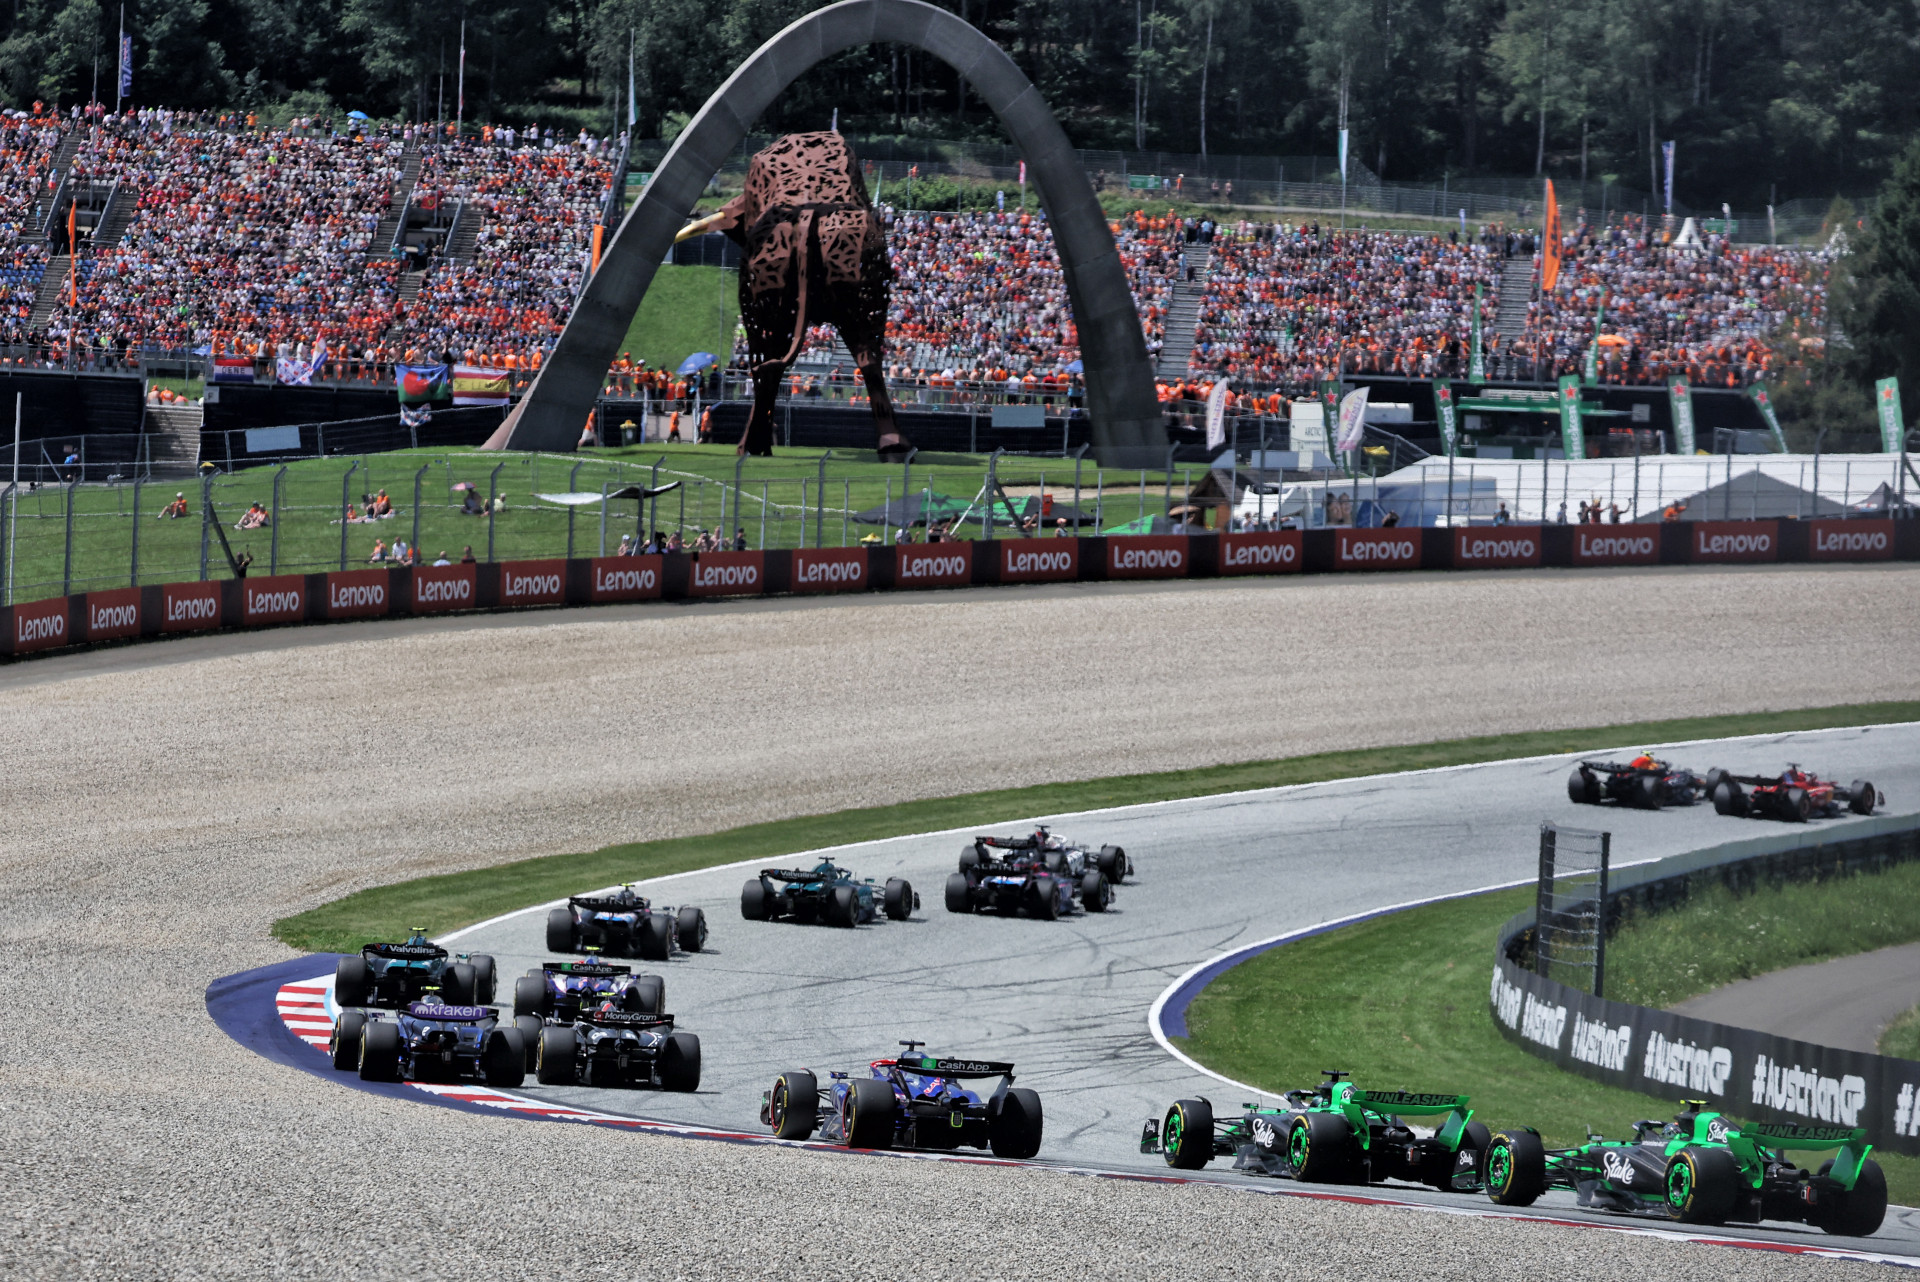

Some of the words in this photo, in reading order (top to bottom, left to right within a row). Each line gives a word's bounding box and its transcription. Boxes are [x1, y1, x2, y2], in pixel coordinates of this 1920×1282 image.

[1341, 538, 1414, 560] Lenovo
[1461, 536, 1535, 559] Lenovo
[1580, 534, 1654, 557] Lenovo
[1699, 532, 1771, 554] Lenovo
[1816, 529, 1887, 551] Lenovo
[902, 555, 966, 577] Lenovo
[1007, 549, 1072, 572] Lenovo
[1113, 546, 1182, 569] Lenovo
[1225, 543, 1296, 566] Lenovo
[596, 567, 655, 592] Lenovo
[694, 563, 758, 586] Lenovo
[798, 559, 861, 582] Lenovo
[330, 583, 384, 608] Lenovo
[417, 577, 470, 602] Lenovo
[505, 572, 560, 596] Lenovo
[168, 596, 217, 621] Lenovo
[248, 589, 300, 614] Lenovo
[18, 615, 64, 642] Lenovo
[91, 604, 137, 630] Lenovo
[389, 944, 436, 954] Valvoline
[595, 965, 613, 973] App
[429, 1004, 483, 1017] kraken
[604, 1011, 657, 1022] MoneyGram
[937, 1060, 965, 1070] Cash
[966, 1062, 990, 1072] App
[1643, 1030, 1732, 1097] #AustrianGP
[1751, 1054, 1866, 1128] #AustrianGP
[1252, 1118, 1275, 1148] Stake
[1707, 1121, 1729, 1143] Stak
[1603, 1151, 1635, 1185] Stake
